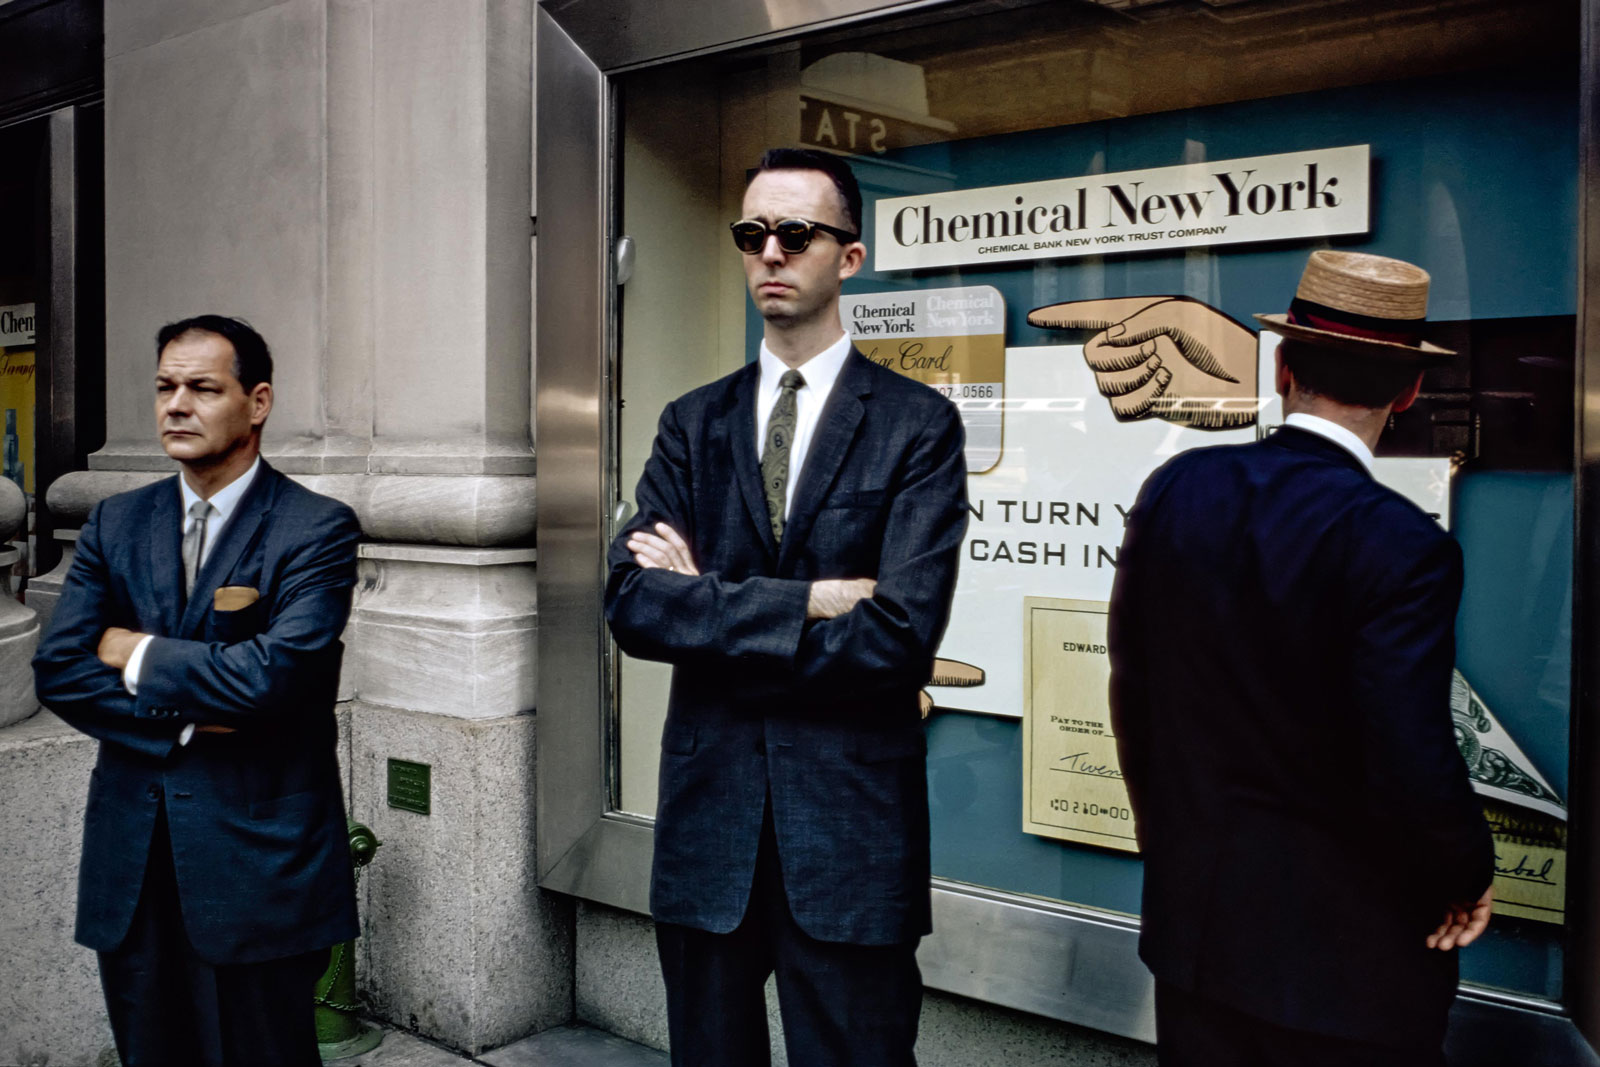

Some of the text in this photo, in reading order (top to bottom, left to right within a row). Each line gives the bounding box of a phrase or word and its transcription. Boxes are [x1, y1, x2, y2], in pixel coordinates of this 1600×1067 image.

[892, 162, 1343, 247] Chemical New York
[978, 225, 1228, 255] CHEMICAL BANK NEW YORK TRUST COMPANY
[853, 302, 916, 318] Chemical
[926, 293, 995, 312] Chemical
[852, 318, 916, 335] New York
[926, 309, 995, 329] New York
[898, 340, 953, 372] Card
[997, 500, 1099, 527] TURN
[970, 539, 1066, 566] CASH
[1063, 641, 1107, 655] EDWARD
[1059, 725, 1090, 735] ORDER
[1085, 721, 1104, 729] THE
